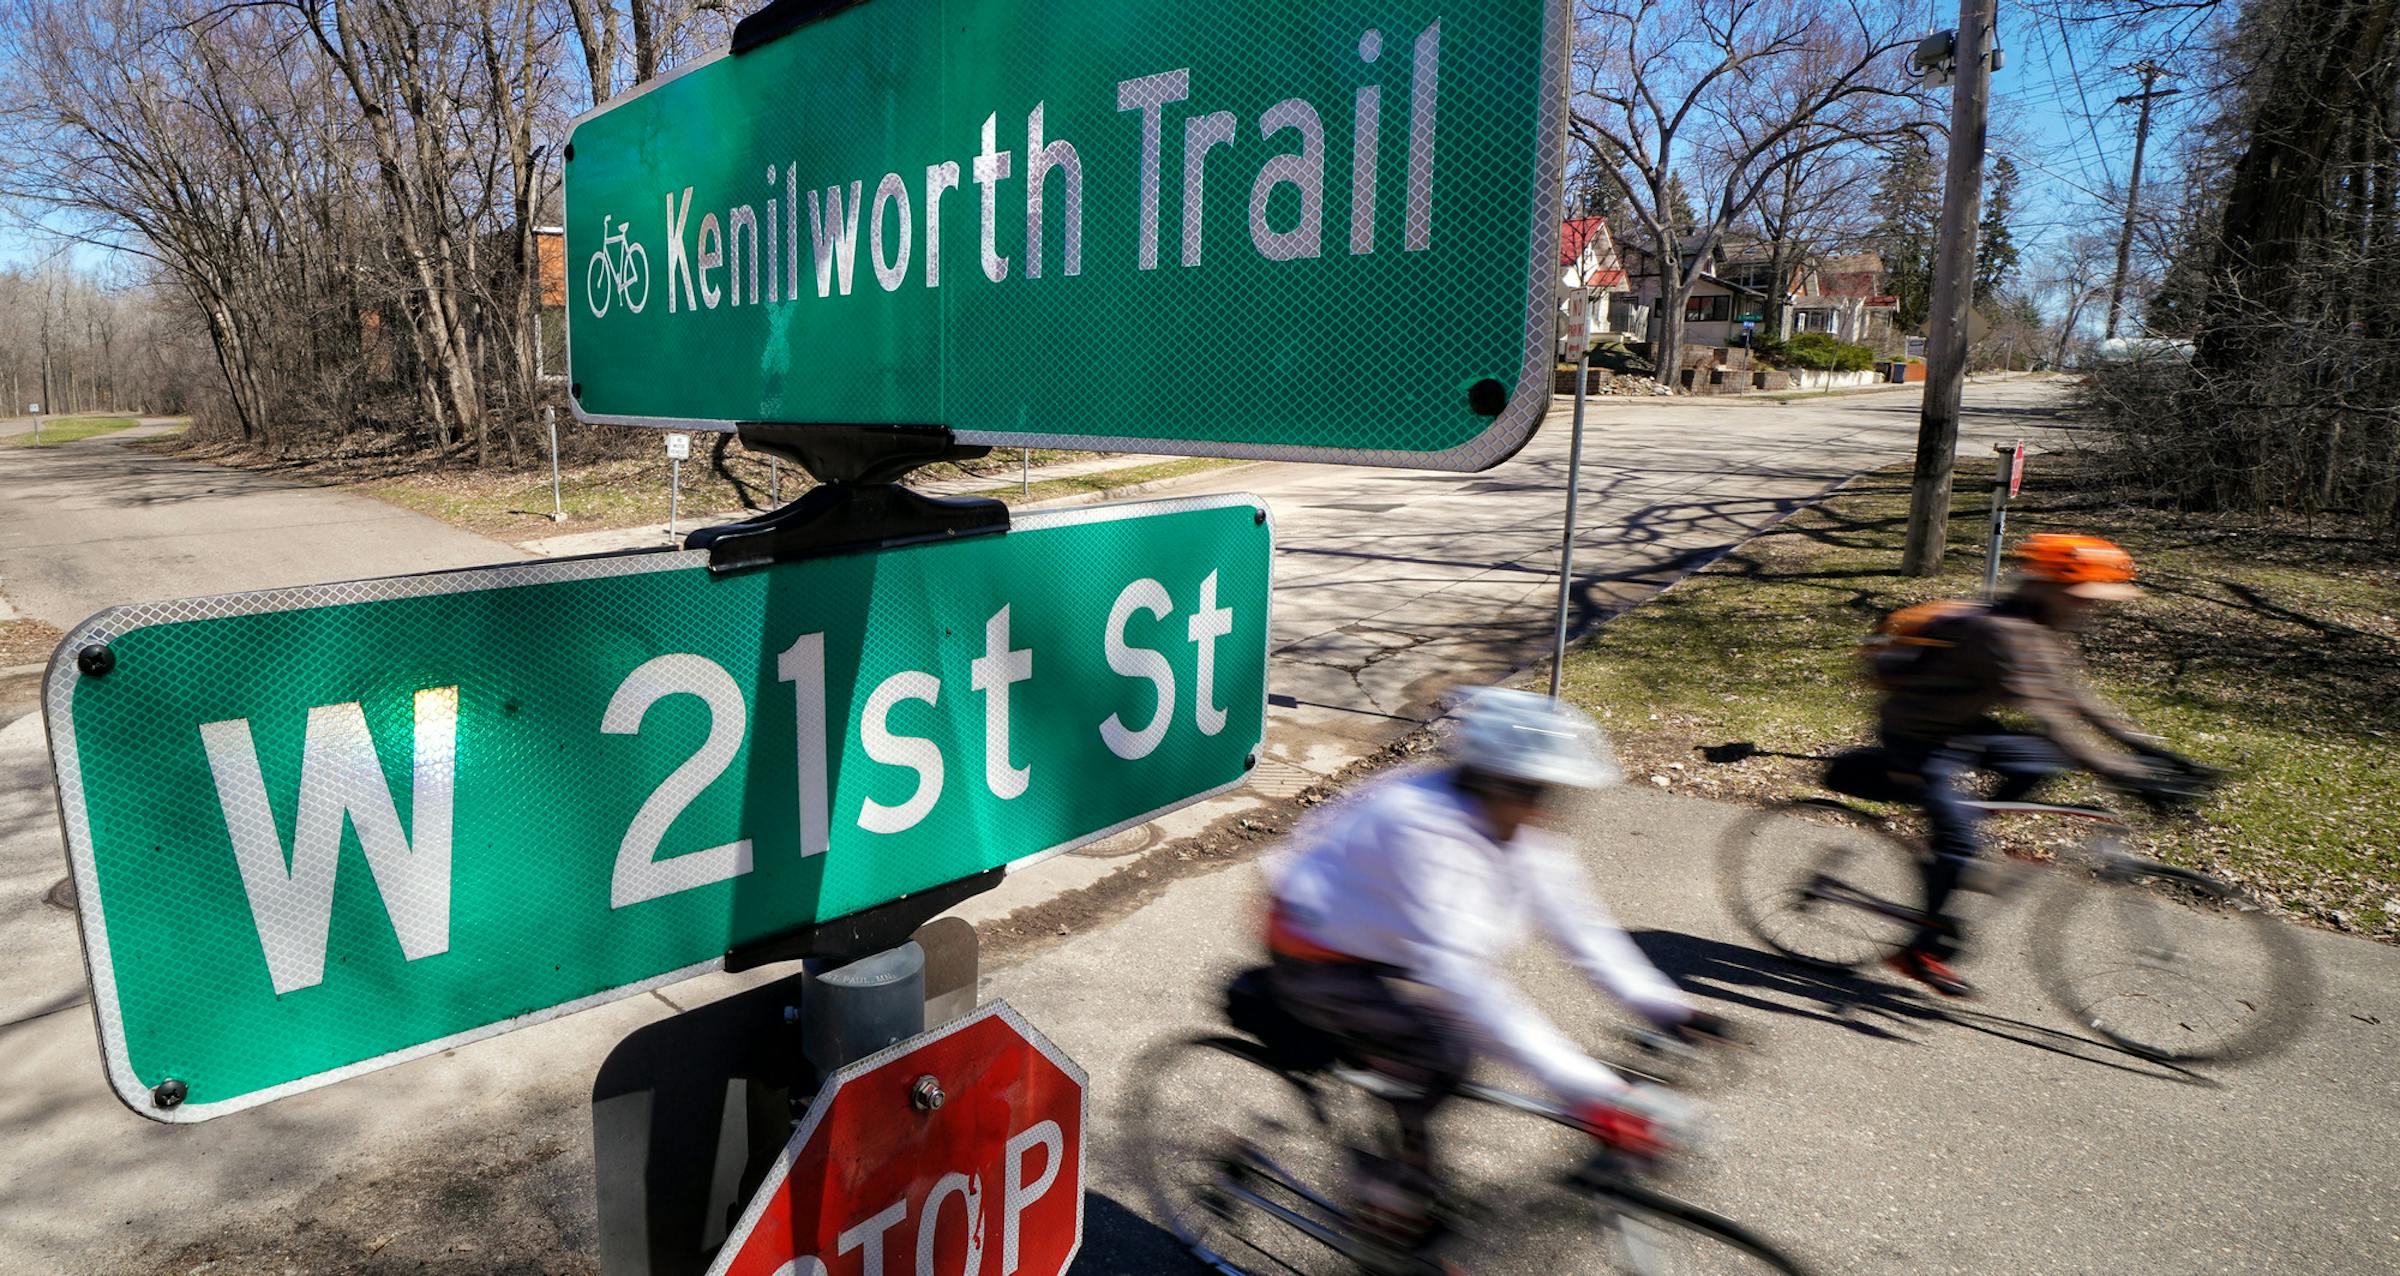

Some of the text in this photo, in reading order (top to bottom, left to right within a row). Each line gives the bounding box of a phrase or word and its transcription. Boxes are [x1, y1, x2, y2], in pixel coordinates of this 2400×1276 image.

[666, 16, 1441, 314] Kenilworth Trail
[199, 570, 1233, 996] W 21st St
[770, 1119, 1064, 1276] TOP
